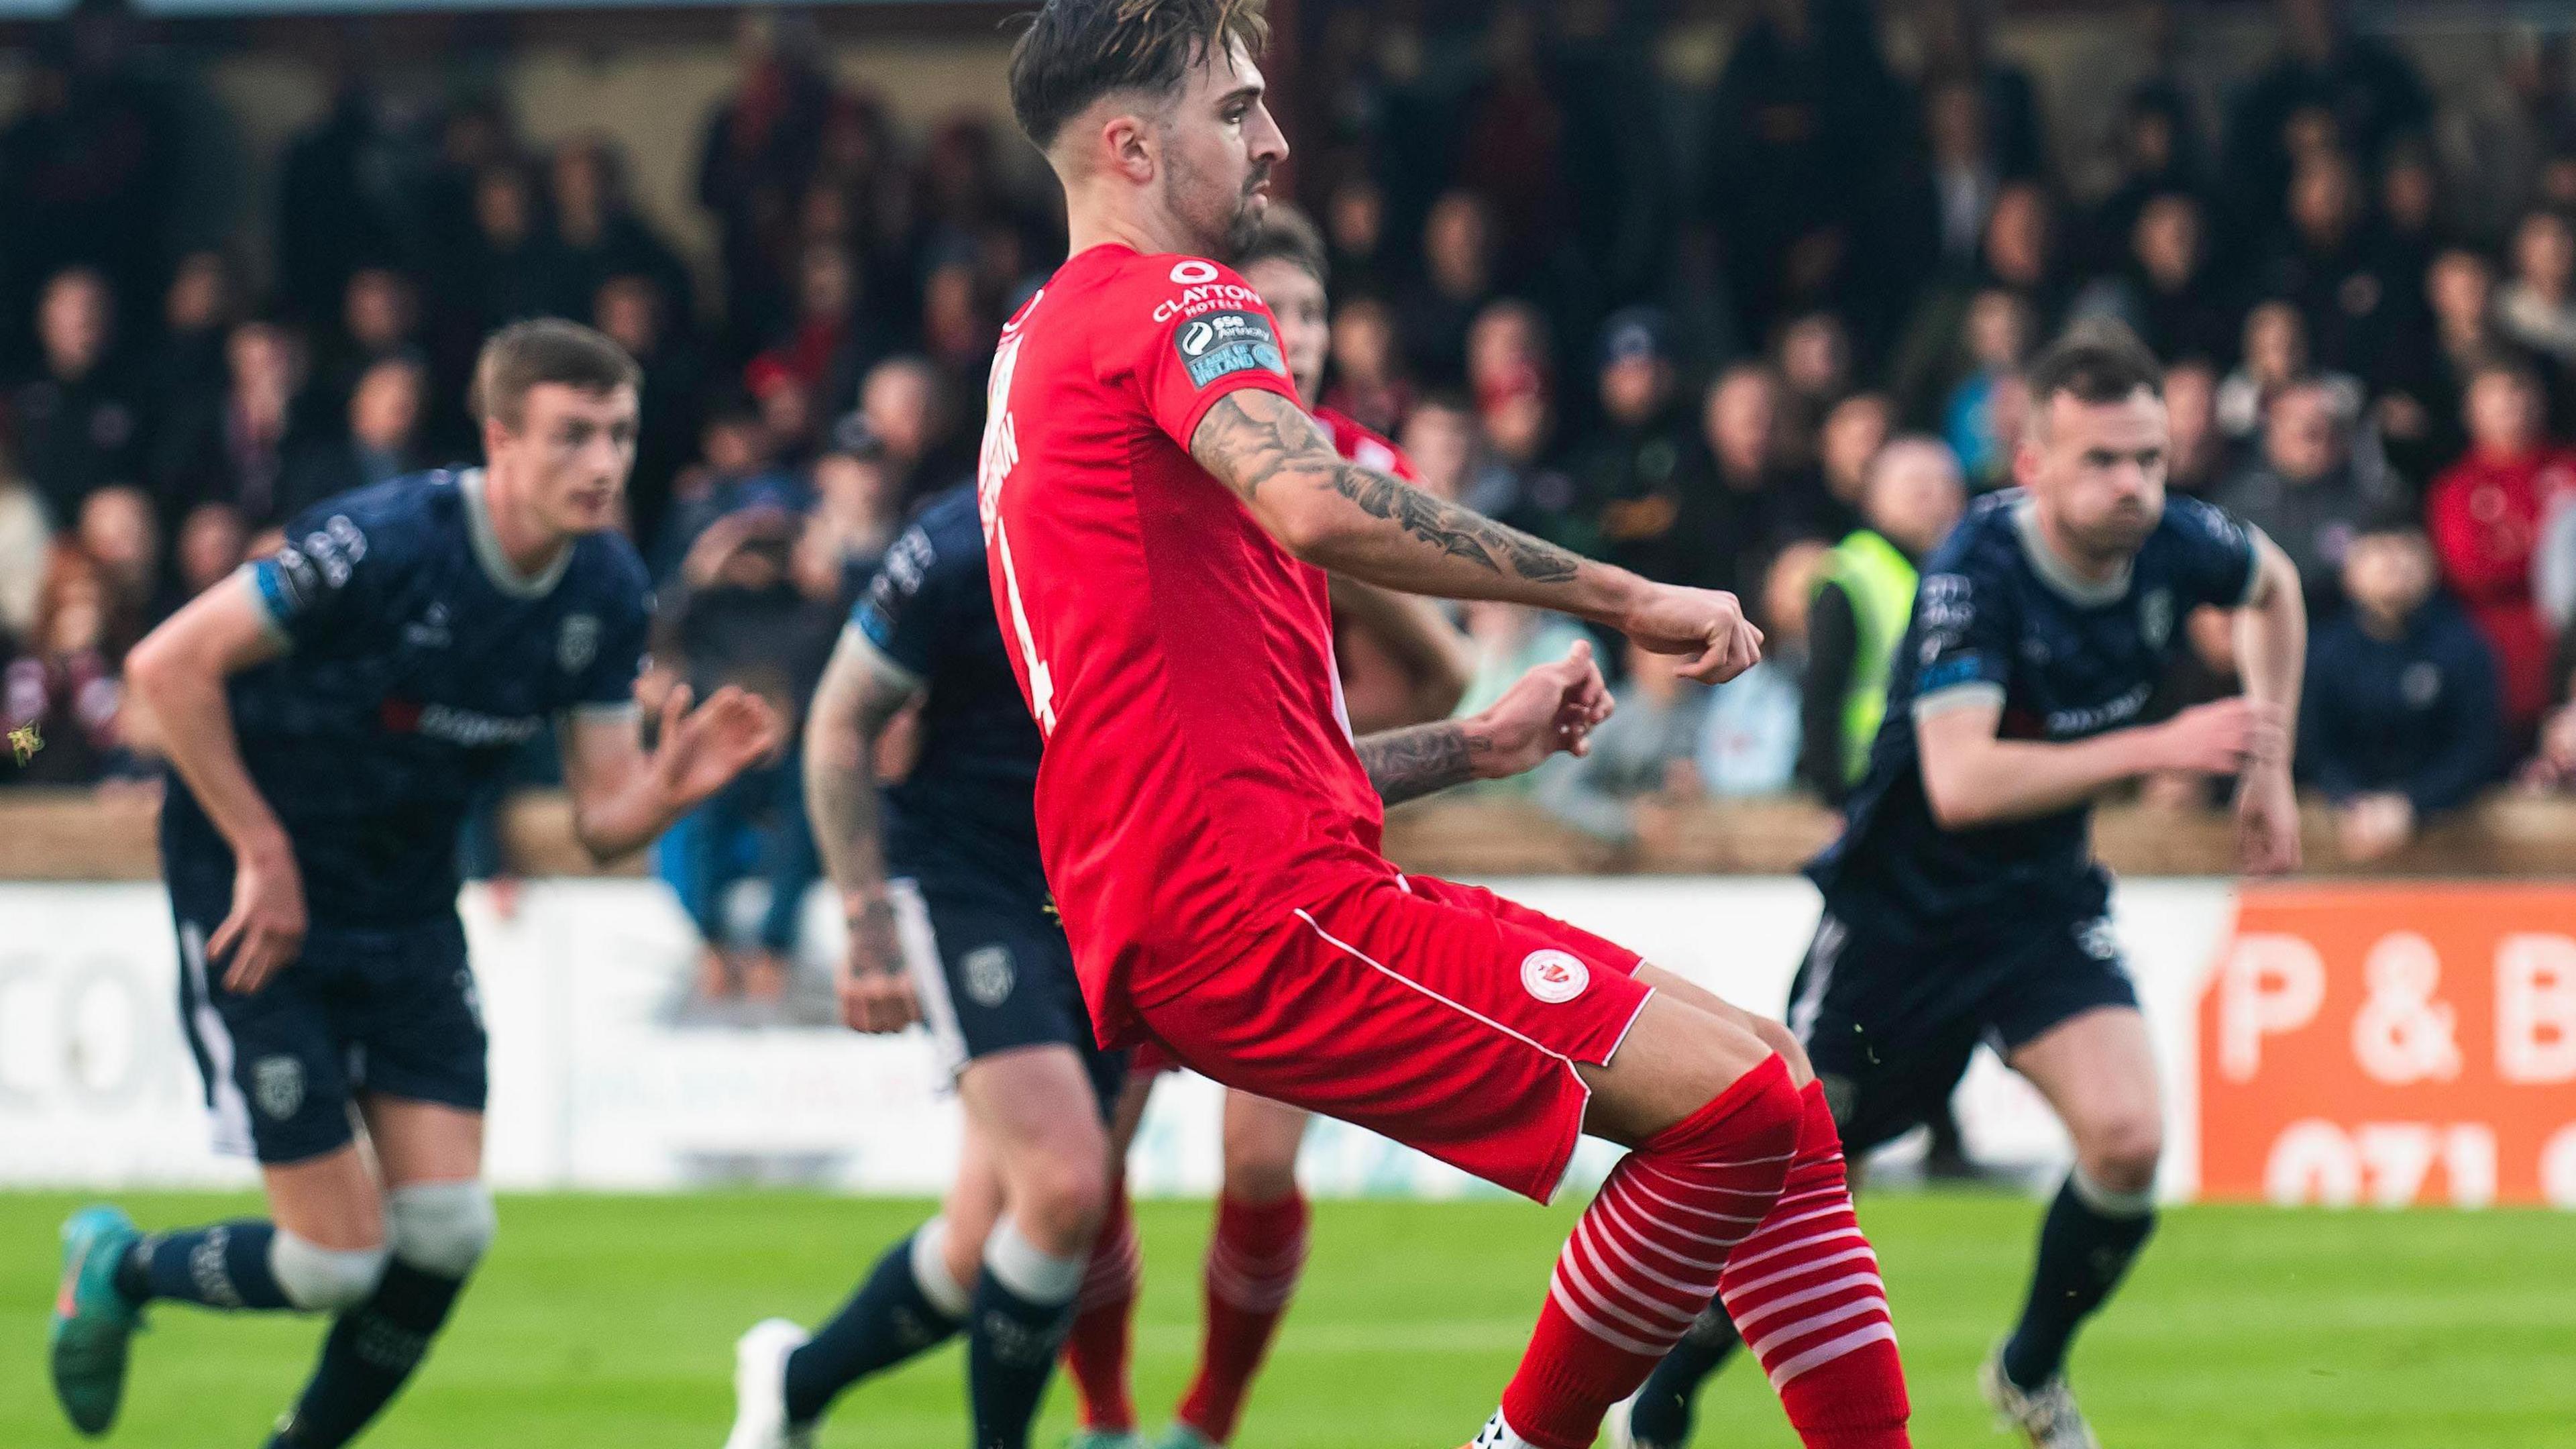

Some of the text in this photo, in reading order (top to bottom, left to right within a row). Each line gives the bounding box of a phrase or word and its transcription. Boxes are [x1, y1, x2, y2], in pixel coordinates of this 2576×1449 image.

[1152, 284, 1263, 323] CLAYTON
[1184, 299, 1242, 317] HOTELS
[2220, 931, 2576, 1085] P & B
